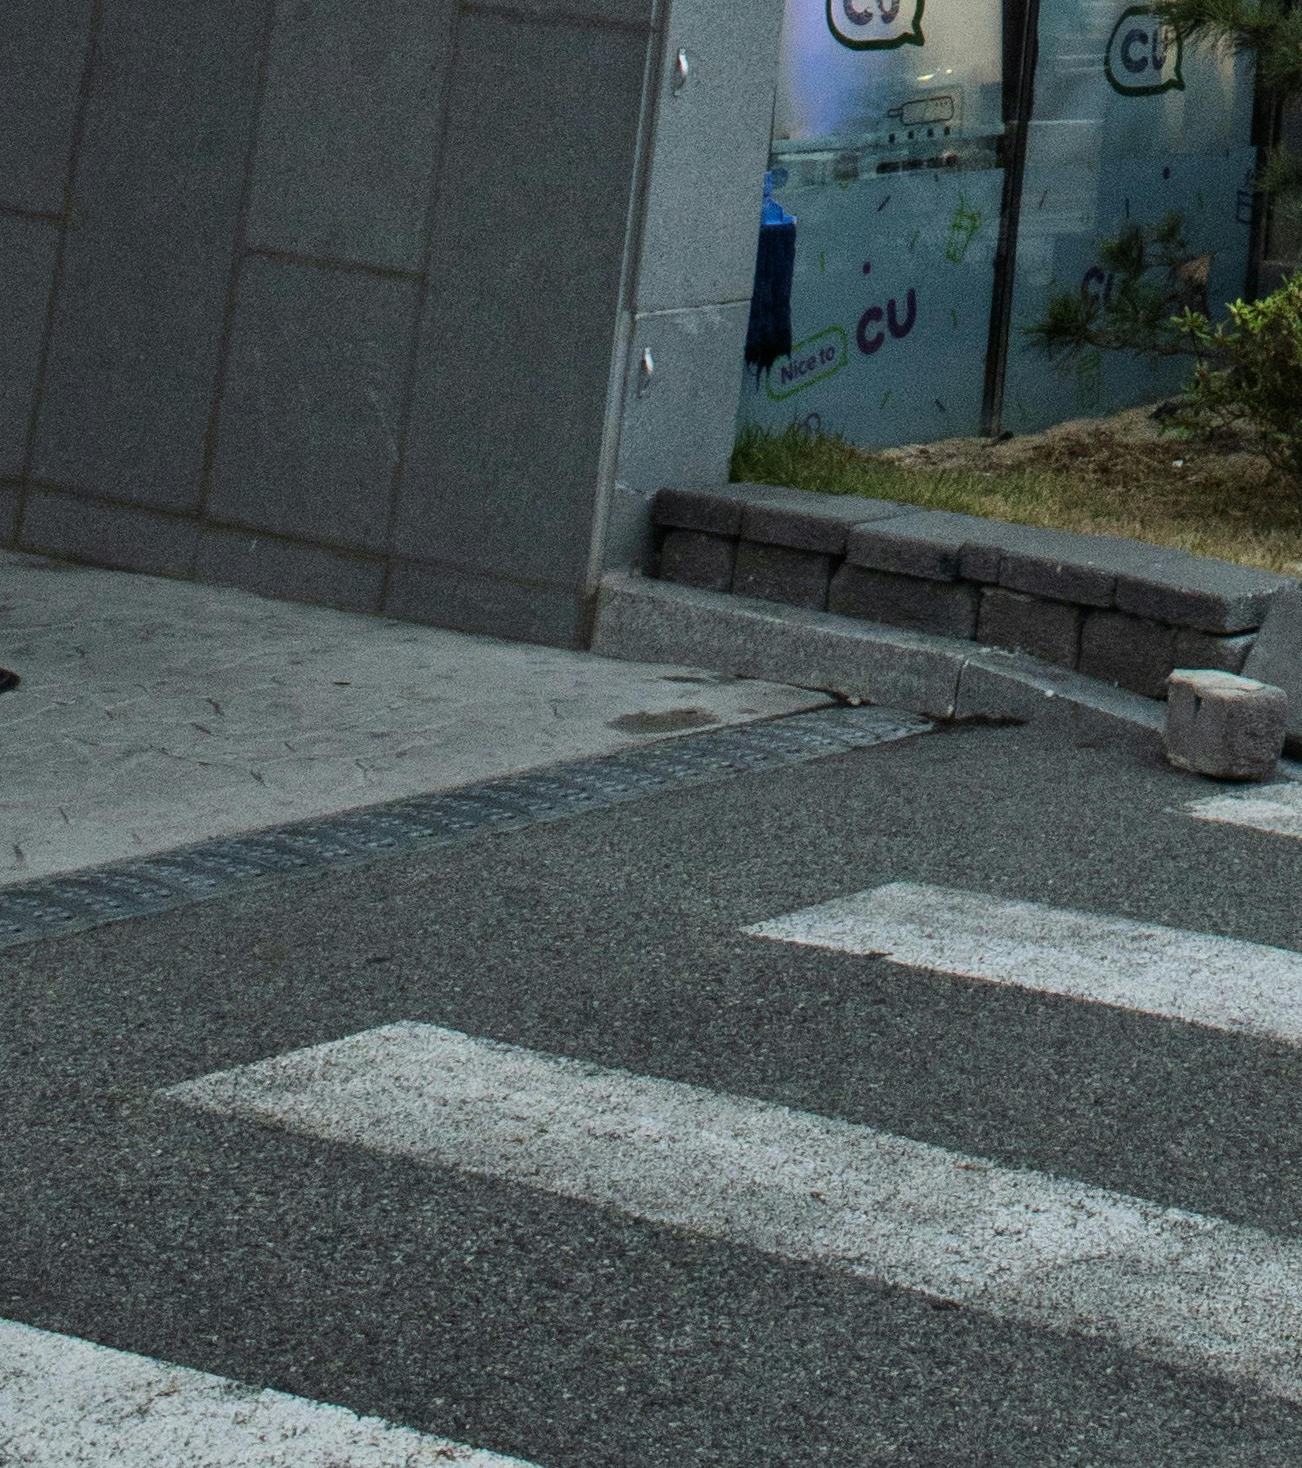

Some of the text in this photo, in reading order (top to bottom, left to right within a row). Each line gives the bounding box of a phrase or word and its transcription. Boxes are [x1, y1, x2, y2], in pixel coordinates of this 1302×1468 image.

[779, 286, 918, 385] Nice to CU
